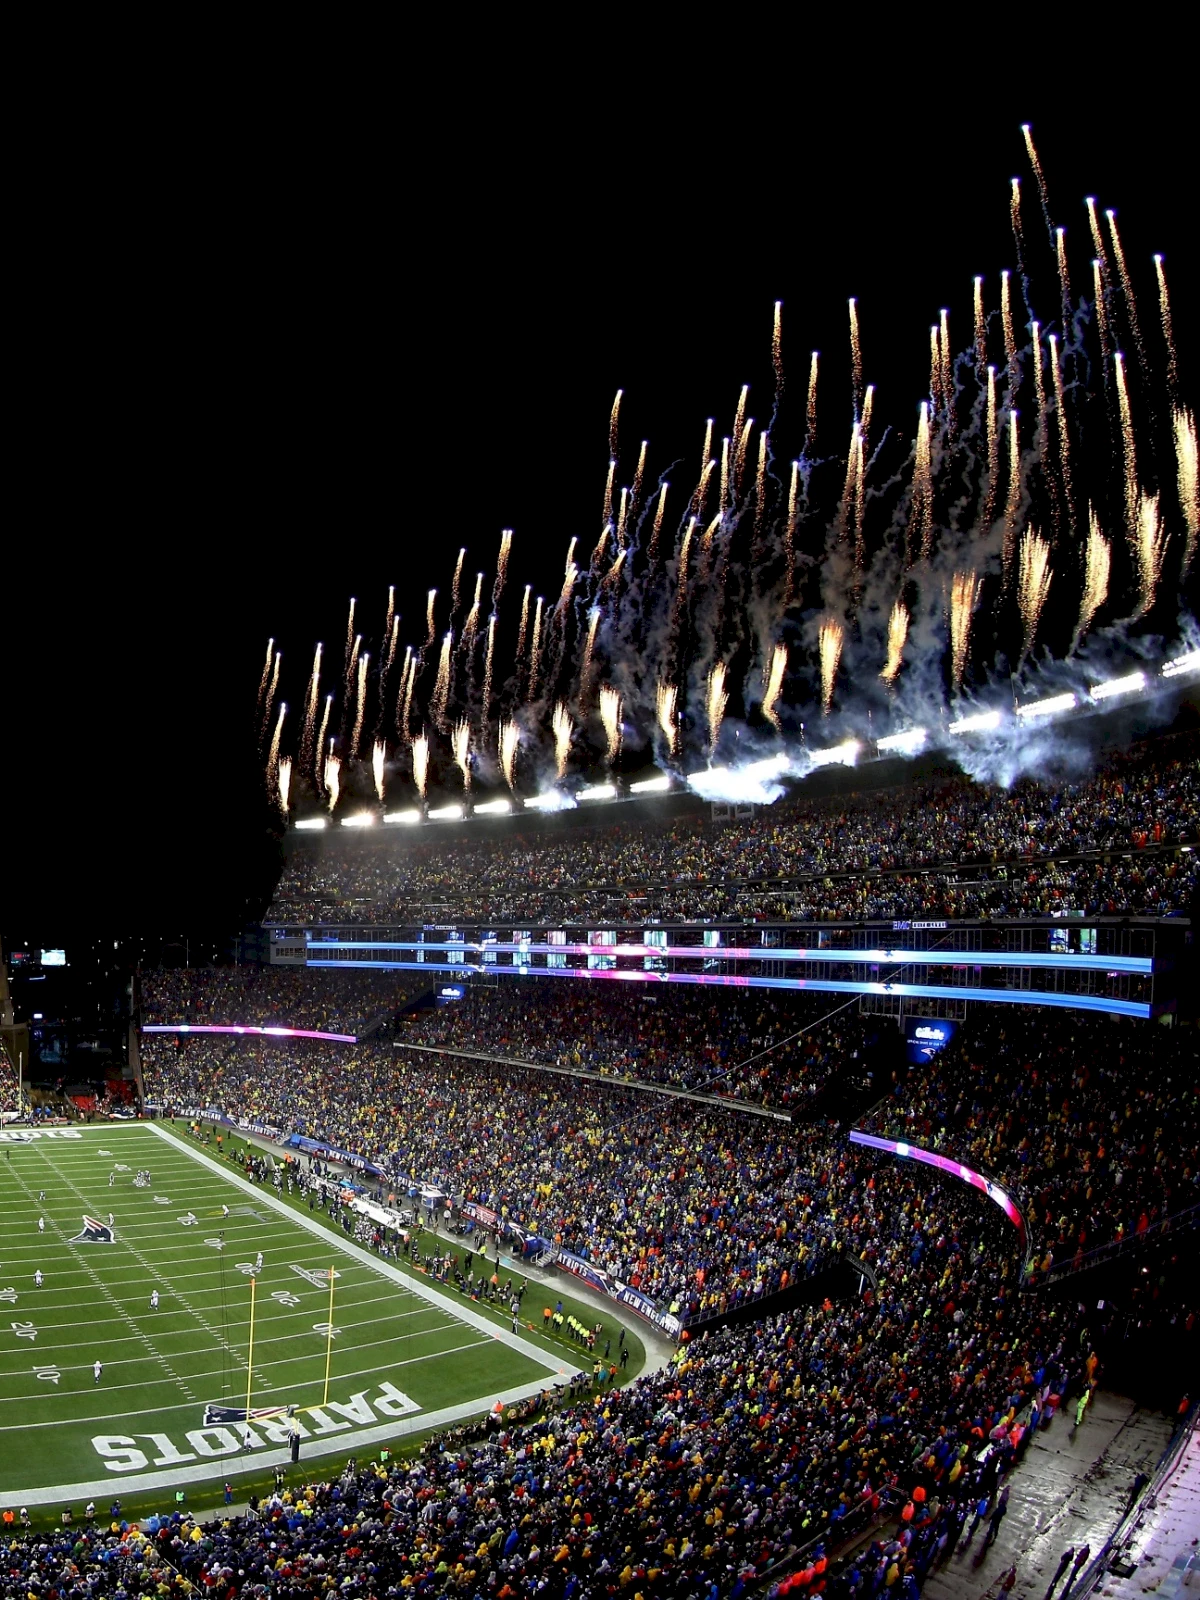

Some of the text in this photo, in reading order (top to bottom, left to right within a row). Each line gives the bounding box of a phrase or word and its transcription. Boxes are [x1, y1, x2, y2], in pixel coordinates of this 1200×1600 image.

[557, 1252, 588, 1277] ATRIOTS
[271, 1290, 301, 1305] 20
[623, 1290, 641, 1309] NEW
[11, 1321, 38, 1337] 20
[32, 1364, 61, 1380] 10
[91, 1381, 423, 1472] PATRIOTS
